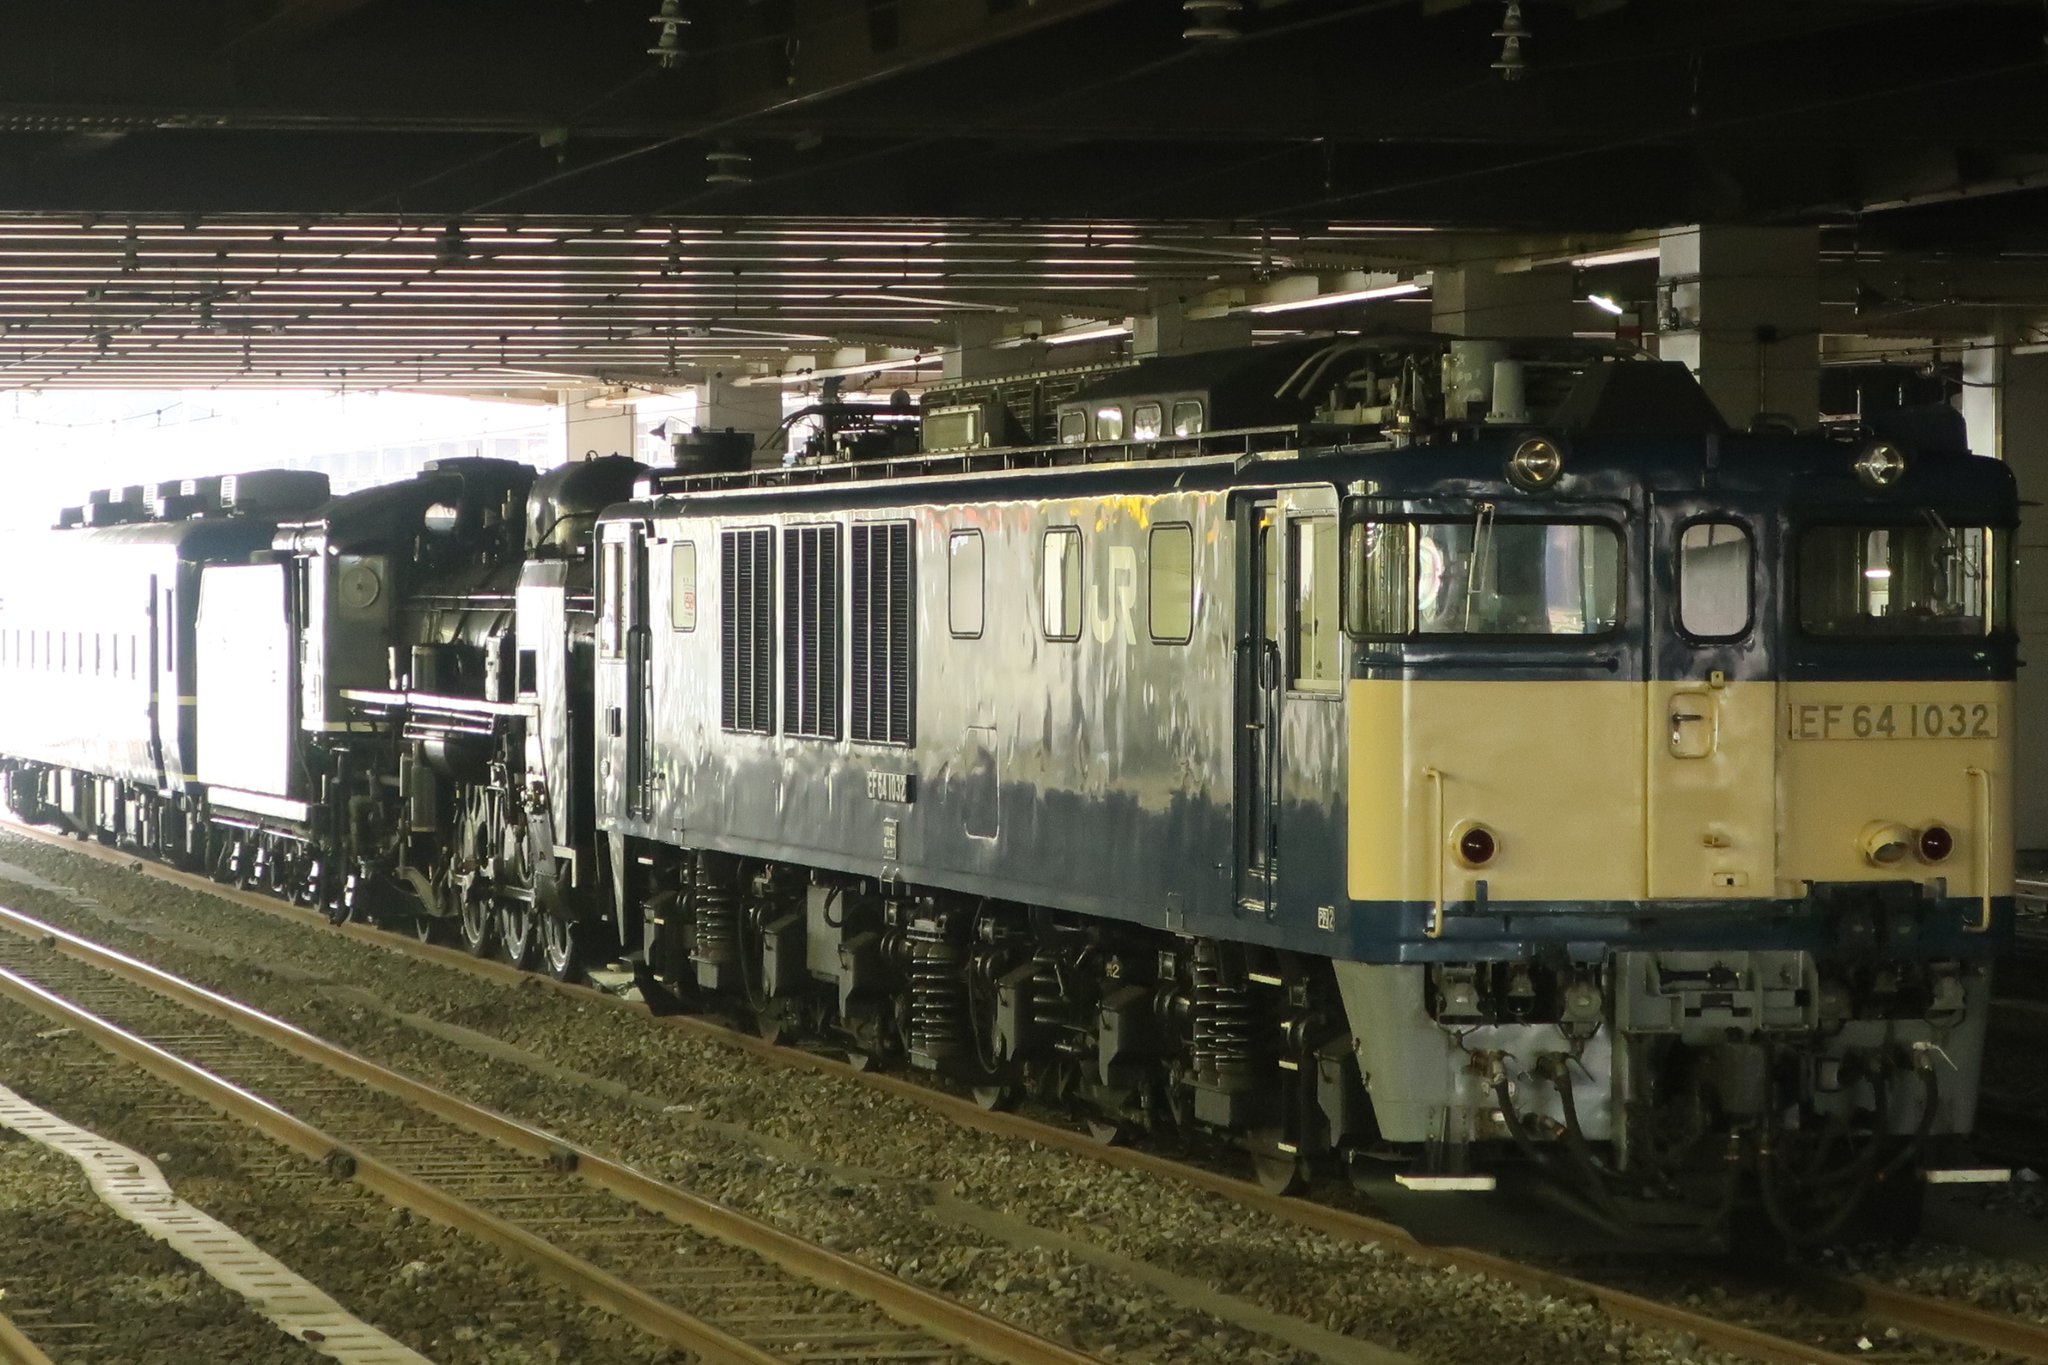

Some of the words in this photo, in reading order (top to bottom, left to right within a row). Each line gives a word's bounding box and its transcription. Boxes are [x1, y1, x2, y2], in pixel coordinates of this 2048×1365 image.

[1089, 545, 1137, 645] JR
[1801, 705, 1843, 738] EF
[1853, 705, 1895, 737] 64
[1911, 704, 1990, 737] 1032
[867, 770, 877, 799] EF
[878, 772, 887, 800] 64
[888, 773, 907, 802] 1032
